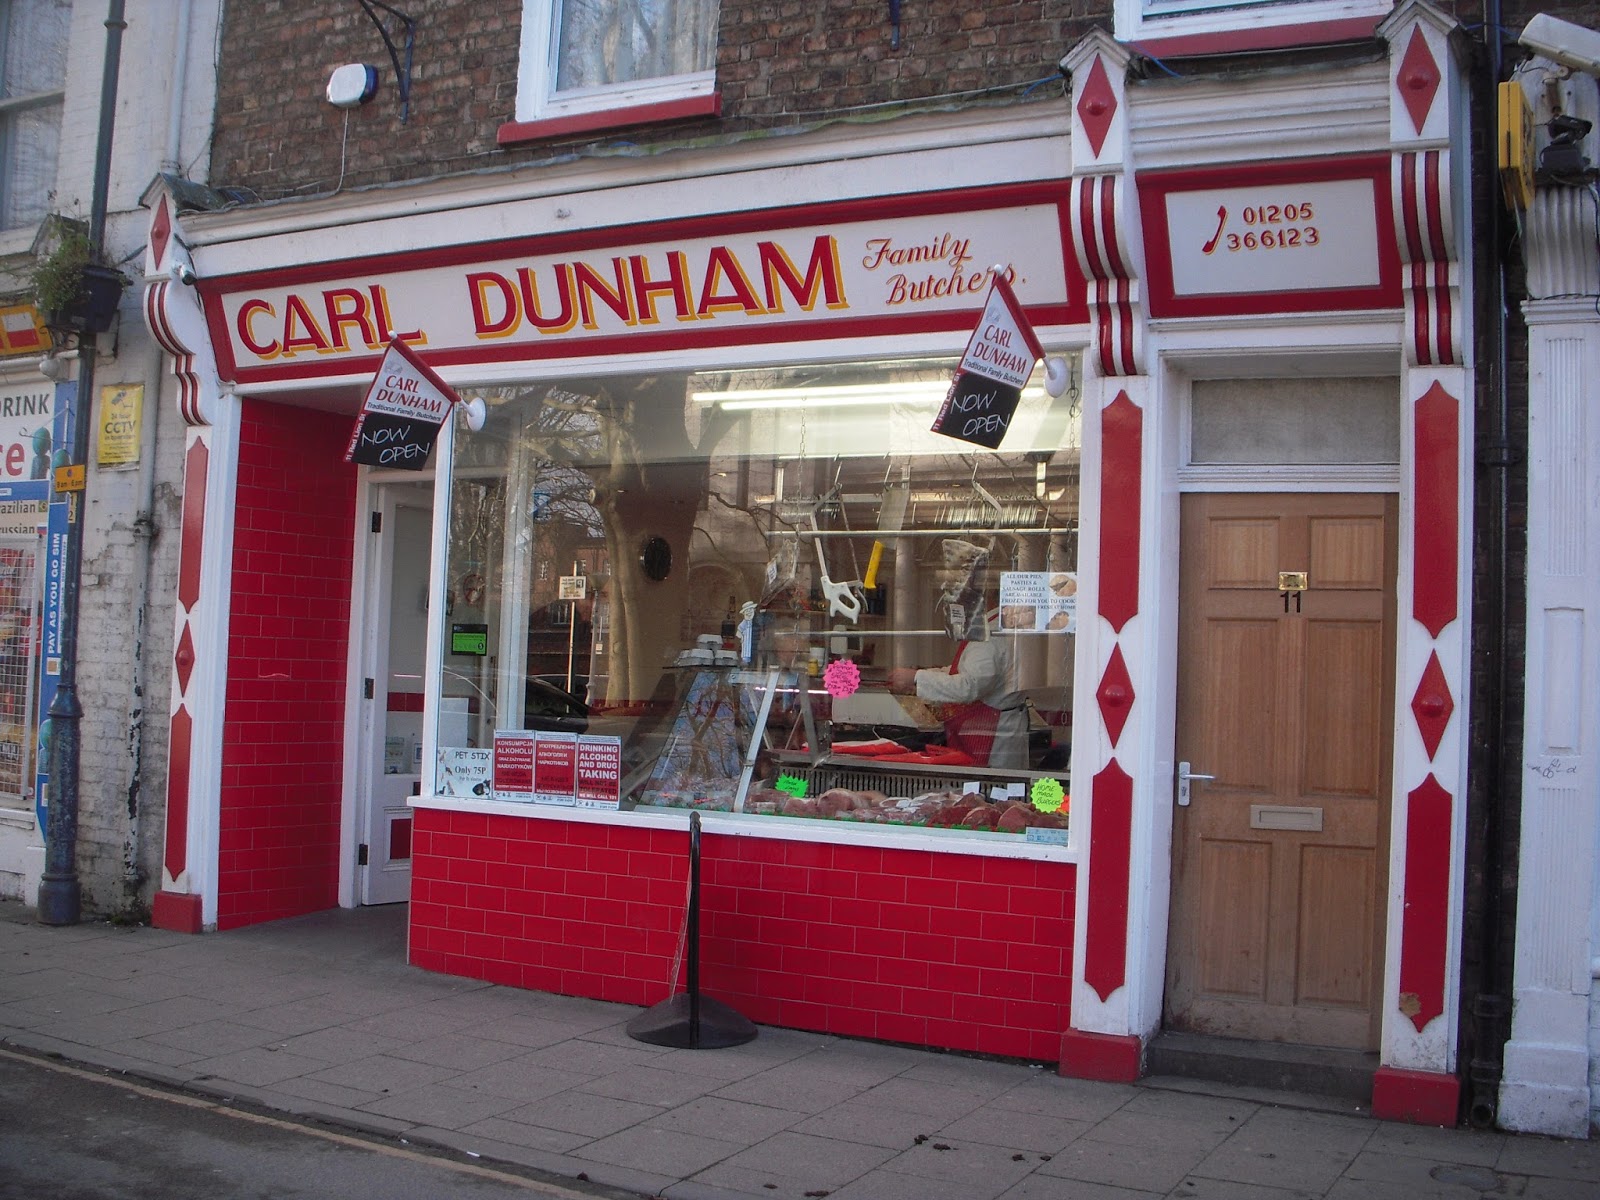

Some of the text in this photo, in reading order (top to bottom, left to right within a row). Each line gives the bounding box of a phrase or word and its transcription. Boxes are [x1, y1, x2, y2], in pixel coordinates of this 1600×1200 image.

[1243, 202, 1313, 225] 01205
[1227, 226, 1320, 251] 366123
[863, 232, 973, 272] Family
[237, 234, 849, 360] CARL DUNHAM
[983, 324, 1012, 348] CARL
[973, 342, 1027, 374] DUNHAM
[964, 358, 1024, 386] Traditional Family Butchers
[385, 375, 420, 393] CARL
[0, 393, 49, 417] RINK
[367, 401, 441, 421] Traditional Family Butchers
[376, 389, 442, 413] DUNHAM
[938, 403, 948, 420] Red
[946, 384, 956, 402] Lion
[950, 390, 997, 414] NOW
[105, 420, 136, 434] CCTV
[361, 425, 411, 447] NOW
[962, 413, 1011, 436] OPEN
[349, 439, 357, 453] Red
[353, 422, 363, 438] Lion
[380, 442, 430, 463] OPEN
[48, 533, 60, 654] PAY AS YOU GO SIM
[1280, 591, 1301, 613] 11
[455, 751, 491, 760] PET STIX
[579, 753, 617, 761] ALCOHOL
[580, 744, 618, 753] DRINKING
[455, 766, 471, 775] Only
[579, 769, 617, 779] TAKING
